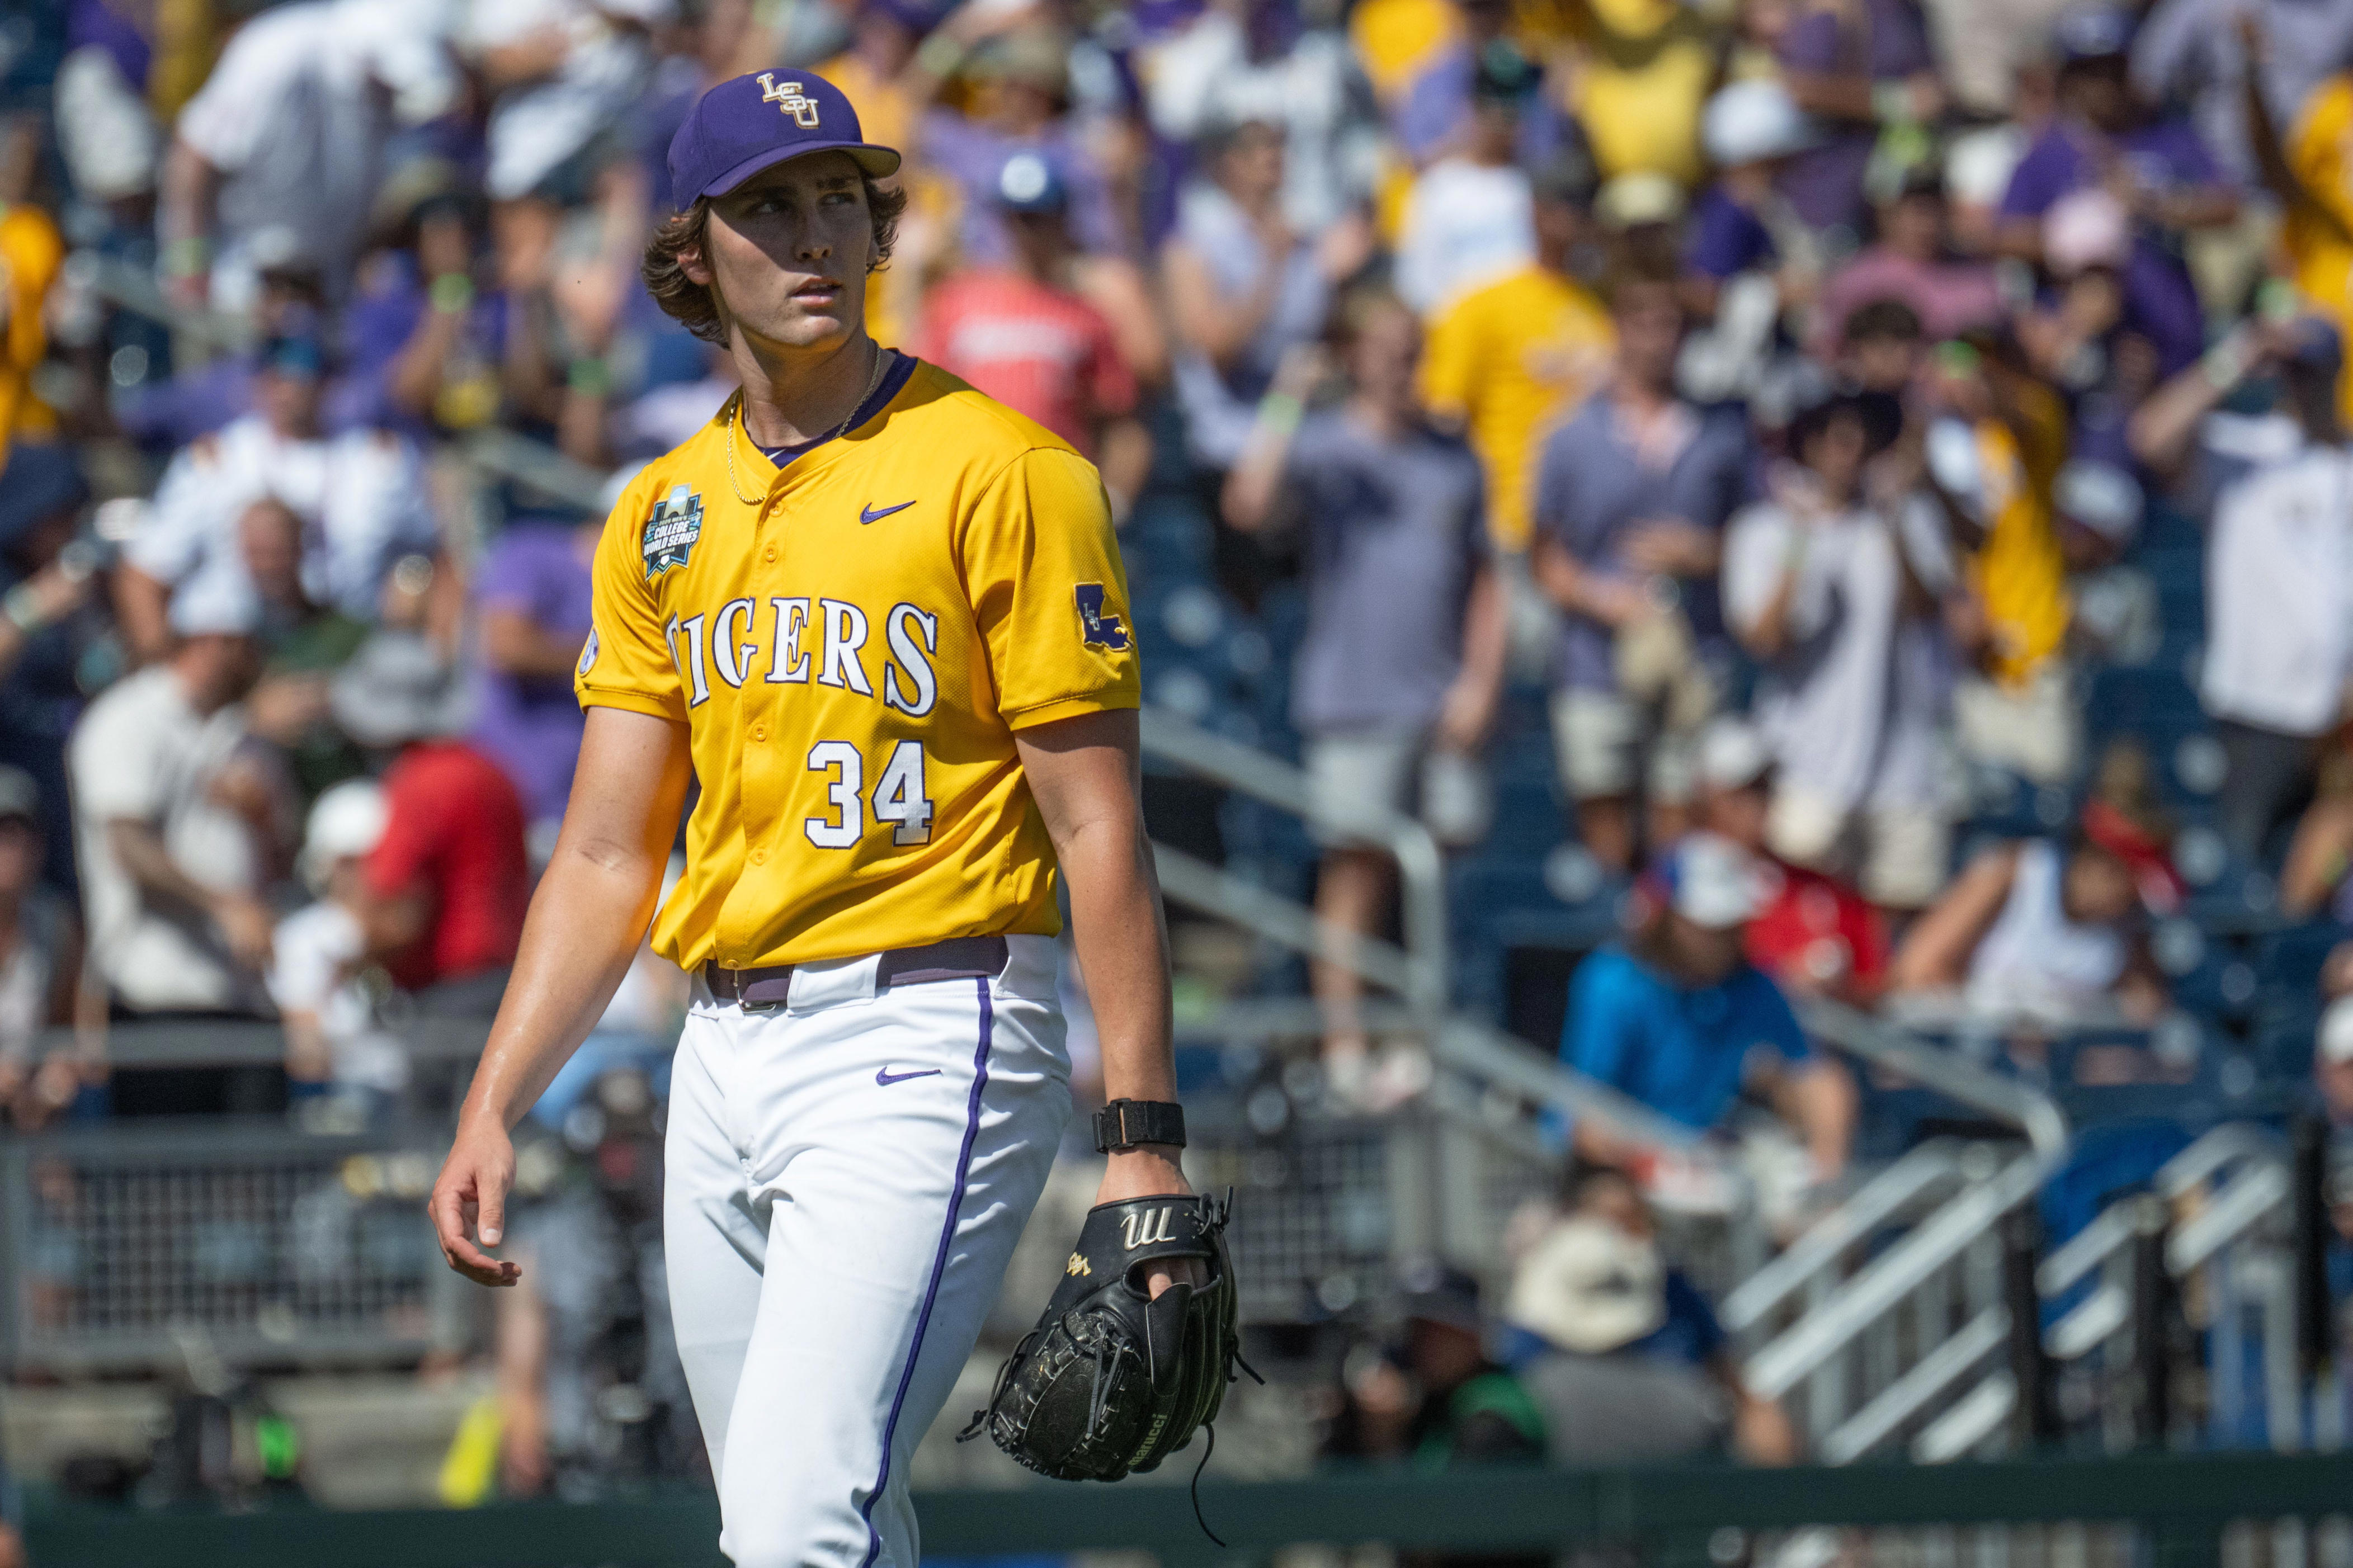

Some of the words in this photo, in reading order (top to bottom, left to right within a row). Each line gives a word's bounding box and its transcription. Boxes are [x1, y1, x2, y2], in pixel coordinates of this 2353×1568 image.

[756, 72, 820, 129] LSU
[644, 536, 669, 556] WORLD
[668, 530, 699, 547] SERIES
[654, 520, 690, 540] COLLEGE
[1083, 603, 1100, 631] LSU
[666, 596, 938, 718] TIGERS
[804, 740, 933, 849] 34
